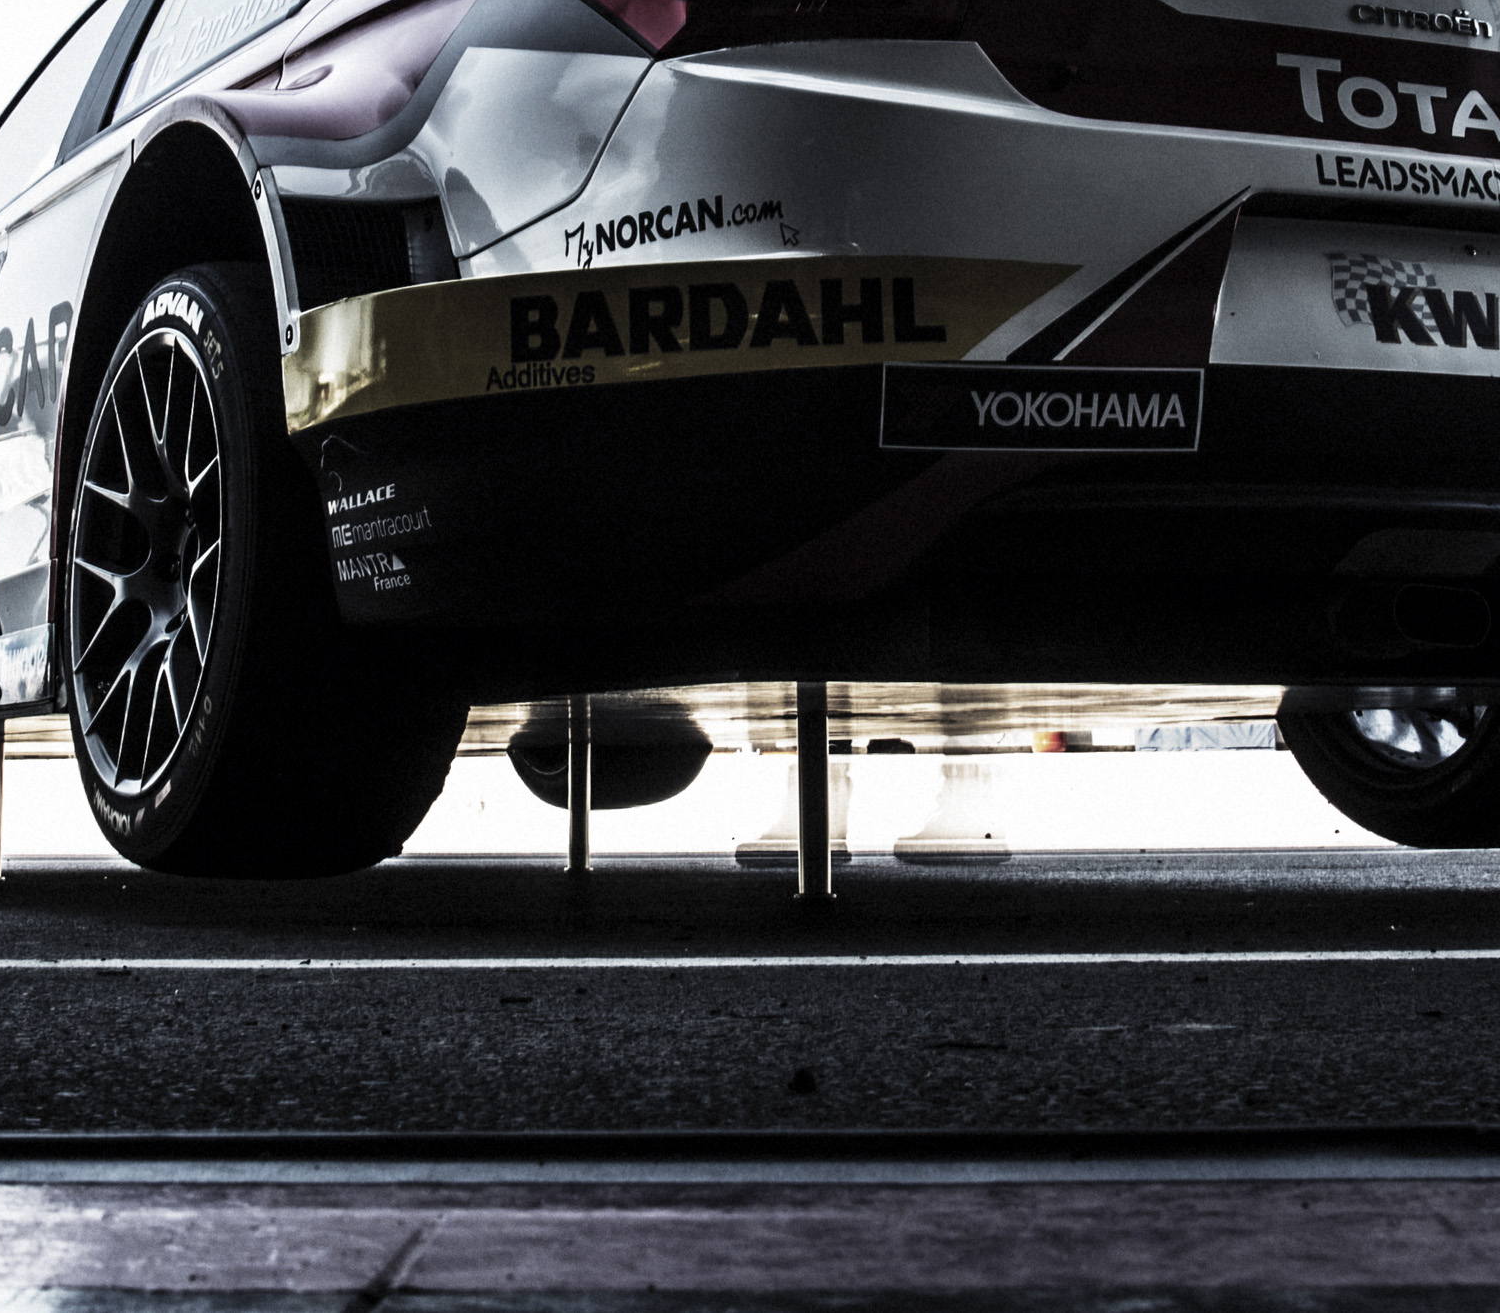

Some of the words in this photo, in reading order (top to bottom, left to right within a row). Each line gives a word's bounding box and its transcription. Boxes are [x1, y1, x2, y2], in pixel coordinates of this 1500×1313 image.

[141, 291, 205, 336] ADVAN
[510, 276, 947, 364] BARDAHL
[1363, 282, 1500, 350] KW
[485, 362, 596, 391] Additives
[970, 390, 1186, 428] YOKOHAMA
[327, 483, 396, 516] WALLACE
[373, 573, 412, 591] France
